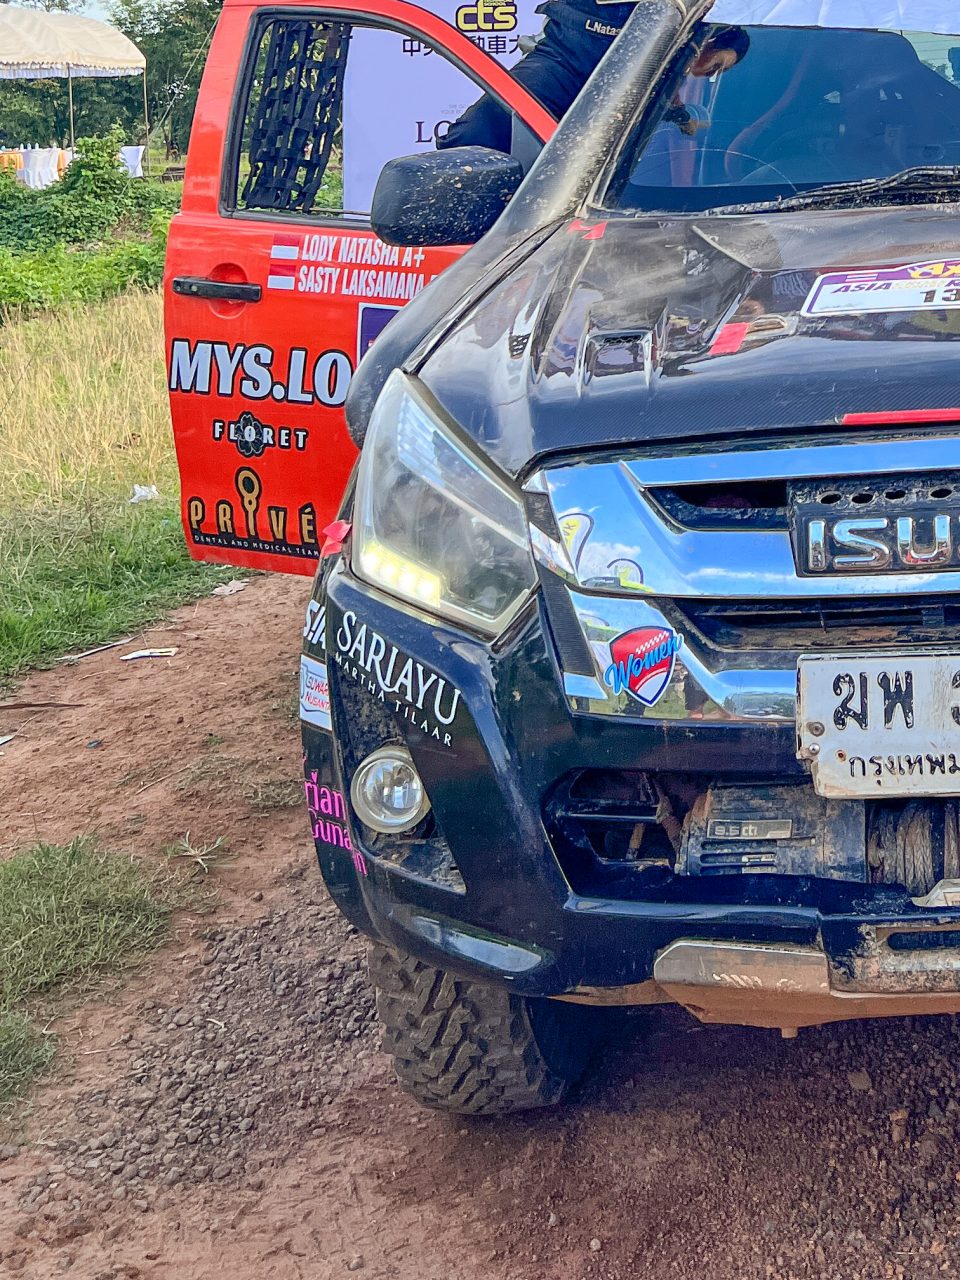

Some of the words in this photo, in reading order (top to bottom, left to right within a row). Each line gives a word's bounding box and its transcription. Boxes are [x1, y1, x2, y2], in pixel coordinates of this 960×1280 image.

[301, 234, 338, 262] LODY
[338, 237, 398, 266] NATASHA
[401, 247, 426, 268] A+
[298, 265, 340, 294] SASTY
[341, 269, 425, 300] LAKSAMANA
[831, 282, 892, 294] ASIA
[170, 338, 353, 408] MYS.LO
[213, 418, 308, 452] FLORET
[194, 534, 228, 547] DENTAL
[231, 539, 249, 548] AND
[252, 541, 292, 554] MEDICAL
[295, 546, 320, 557] TEAM
[336, 610, 462, 725] SARIAYU
[604, 634, 684, 695] Women
[335, 651, 386, 702] MARTHA
[394, 699, 452, 747] TILAAR
